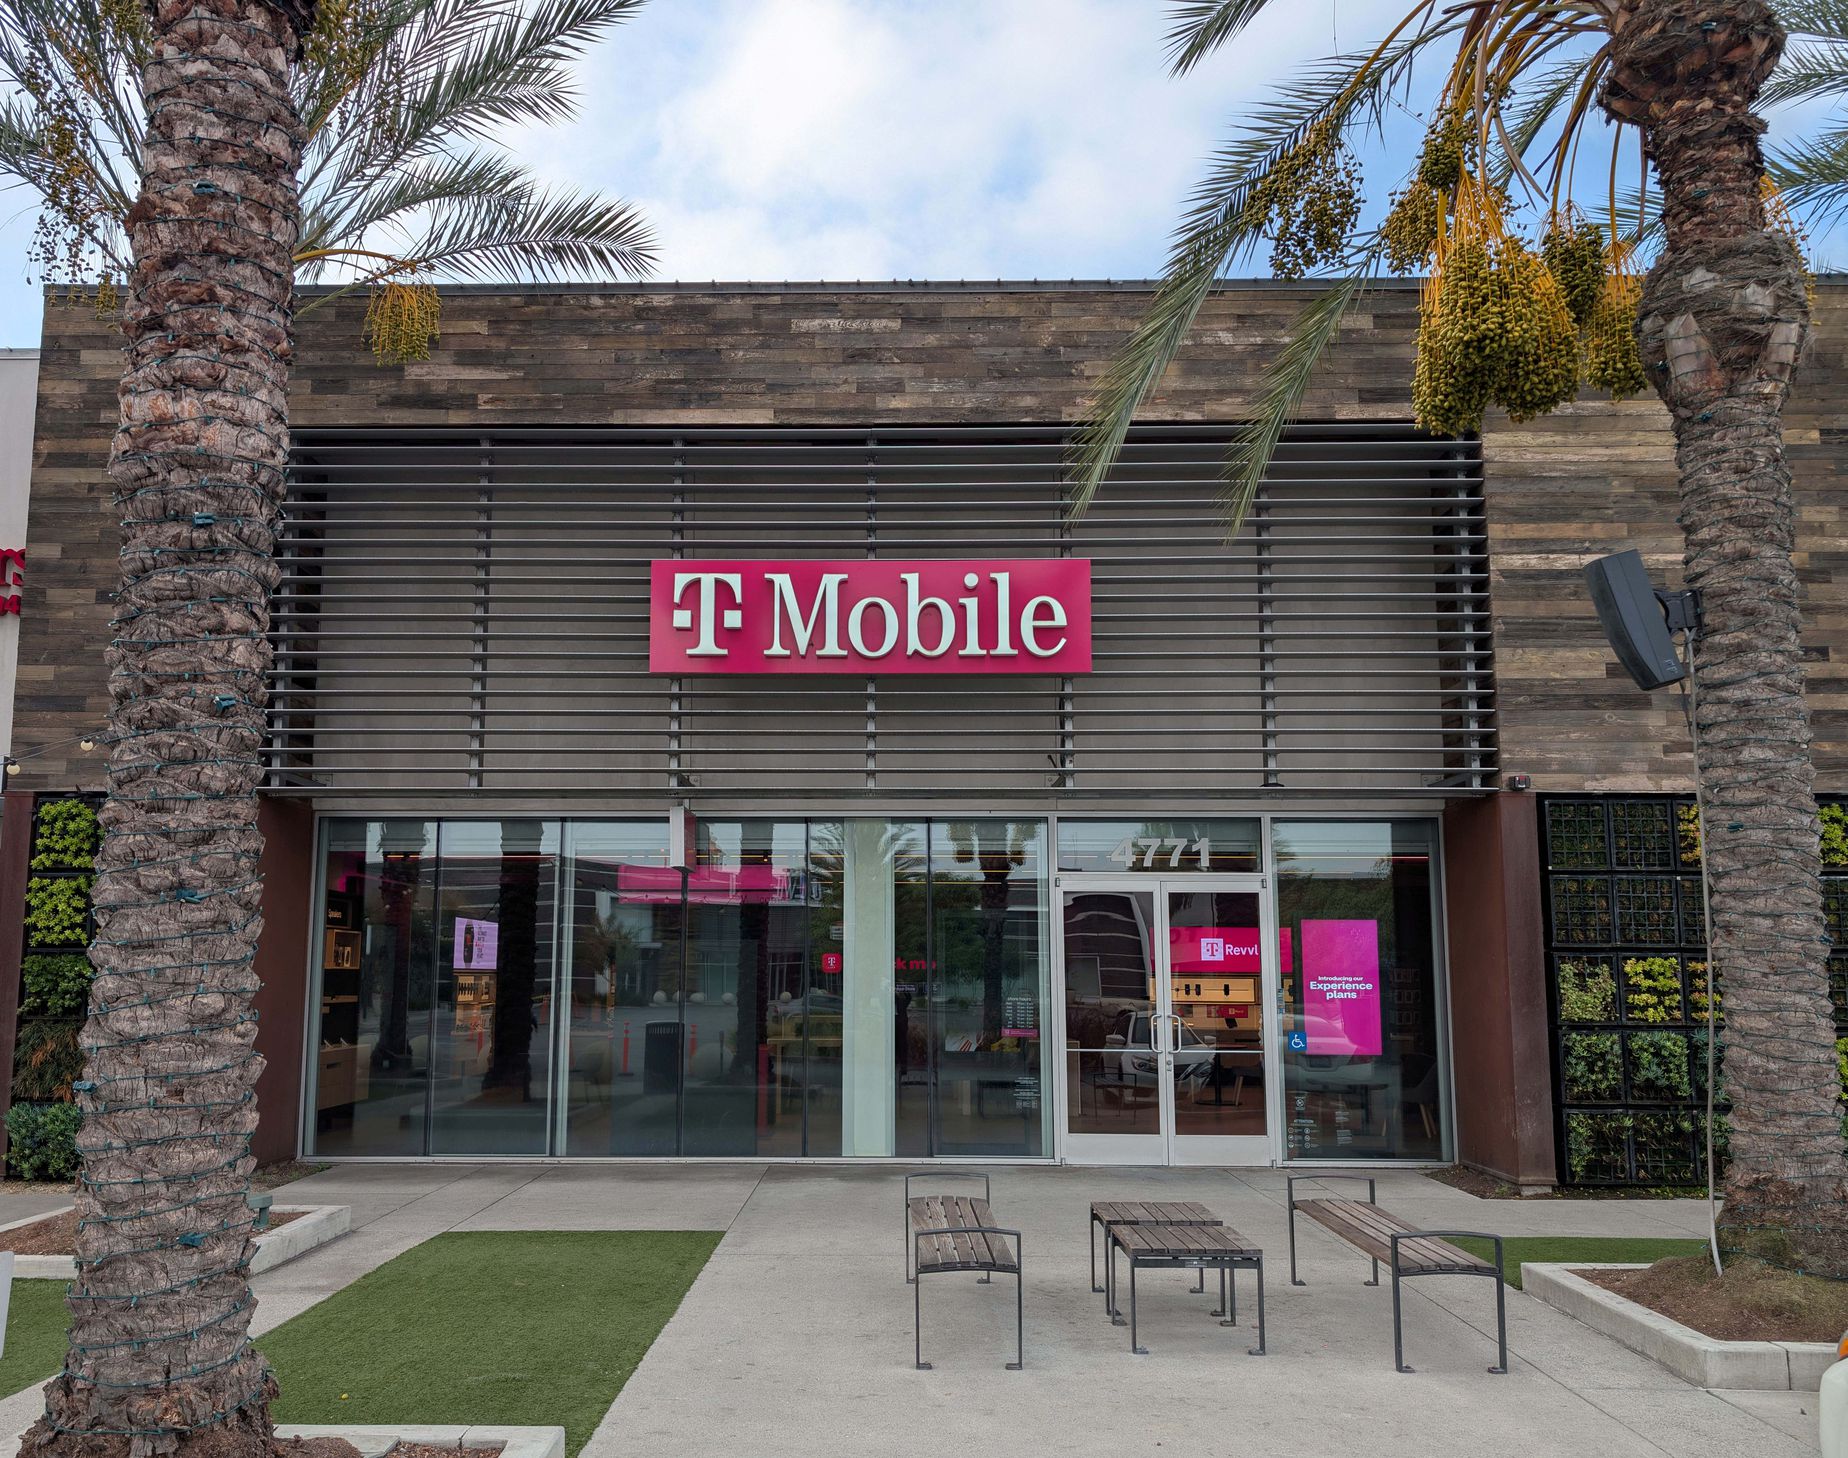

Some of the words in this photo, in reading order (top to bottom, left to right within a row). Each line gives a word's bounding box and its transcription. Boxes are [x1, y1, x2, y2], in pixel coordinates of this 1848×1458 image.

[673, 573, 743, 656] T
[764, 572, 1068, 659] Mobile
[1110, 838, 1210, 867] 4771
[1225, 943, 1259, 956] Revvl
[1309, 981, 1373, 992] Experience
[1326, 990, 1357, 1000] plans
